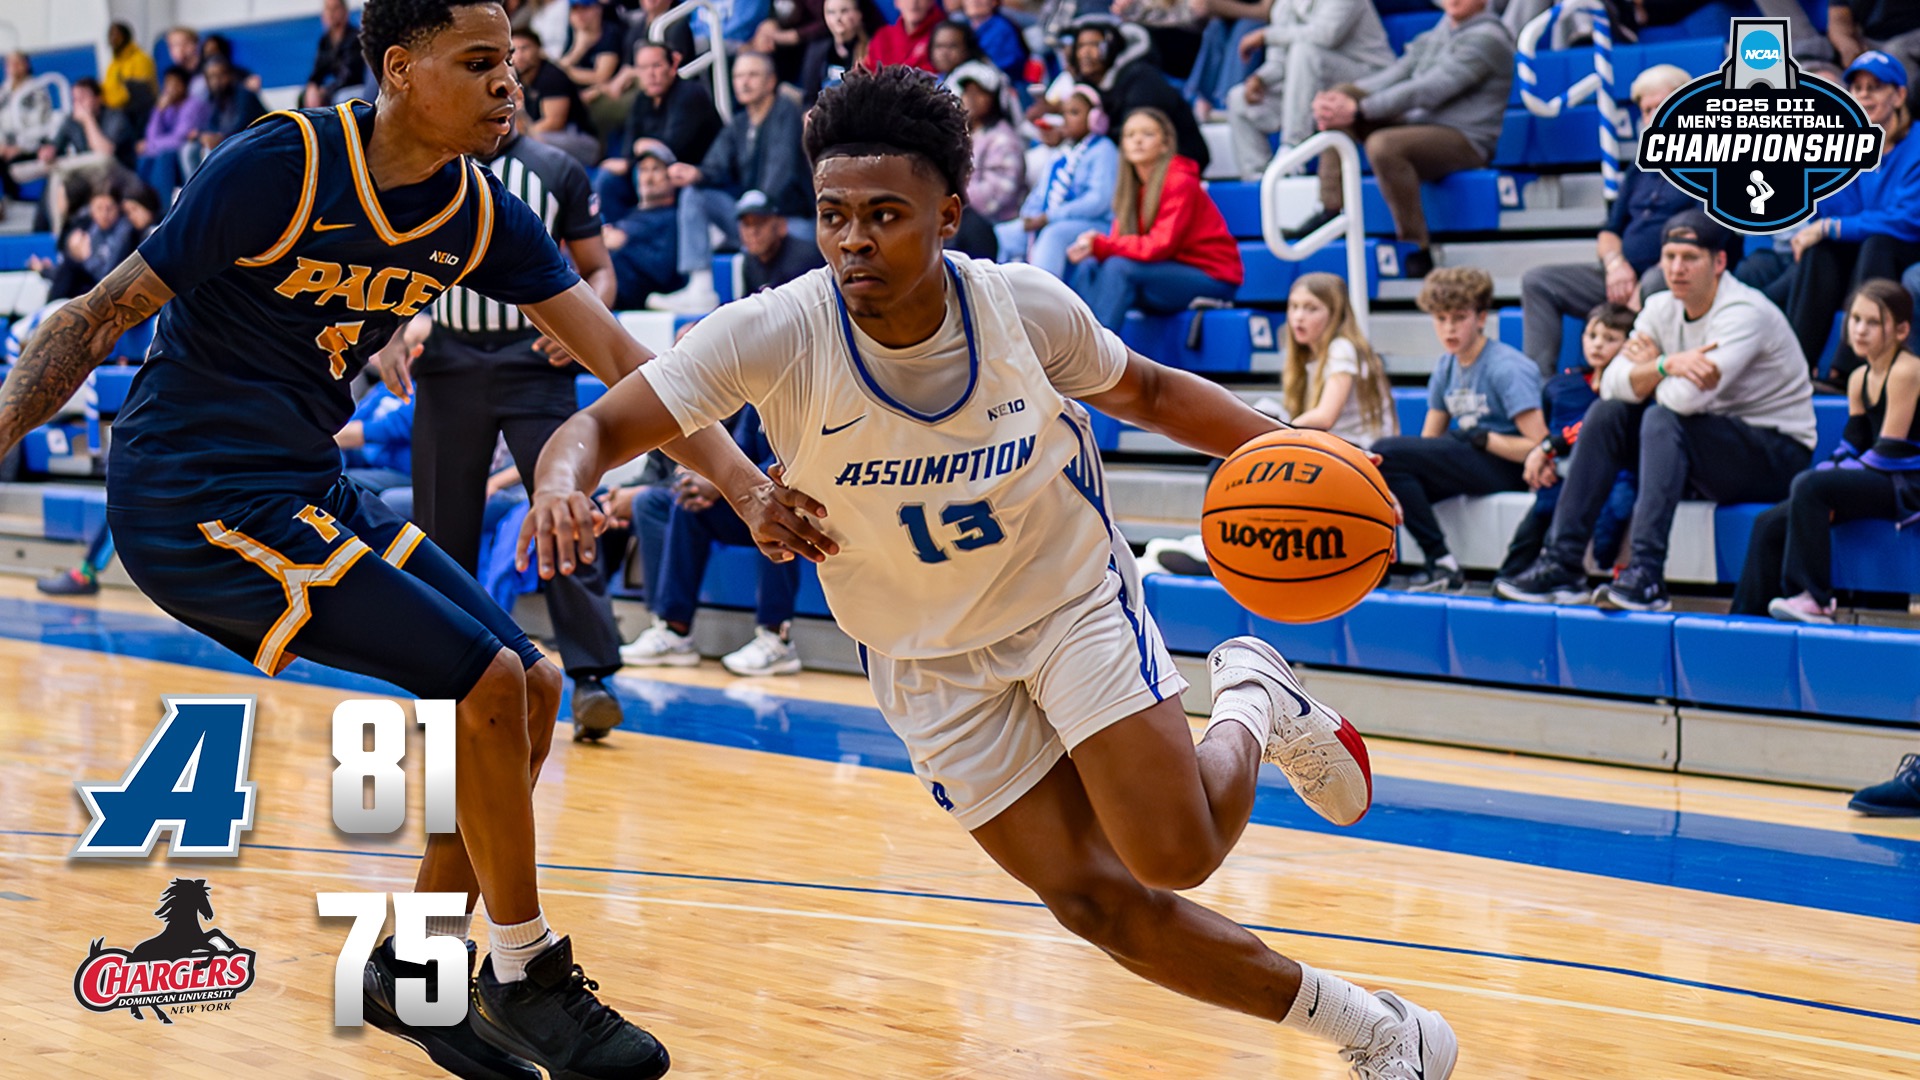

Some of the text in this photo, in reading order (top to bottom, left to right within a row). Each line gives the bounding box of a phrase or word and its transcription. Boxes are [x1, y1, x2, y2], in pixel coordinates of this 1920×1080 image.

[274, 256, 446, 316] PACE
[986, 398, 1026, 422] NE10
[834, 434, 1037, 487] ASSUMPTION
[896, 497, 1008, 564] 13
[1218, 520, 1347, 562] Wilson
